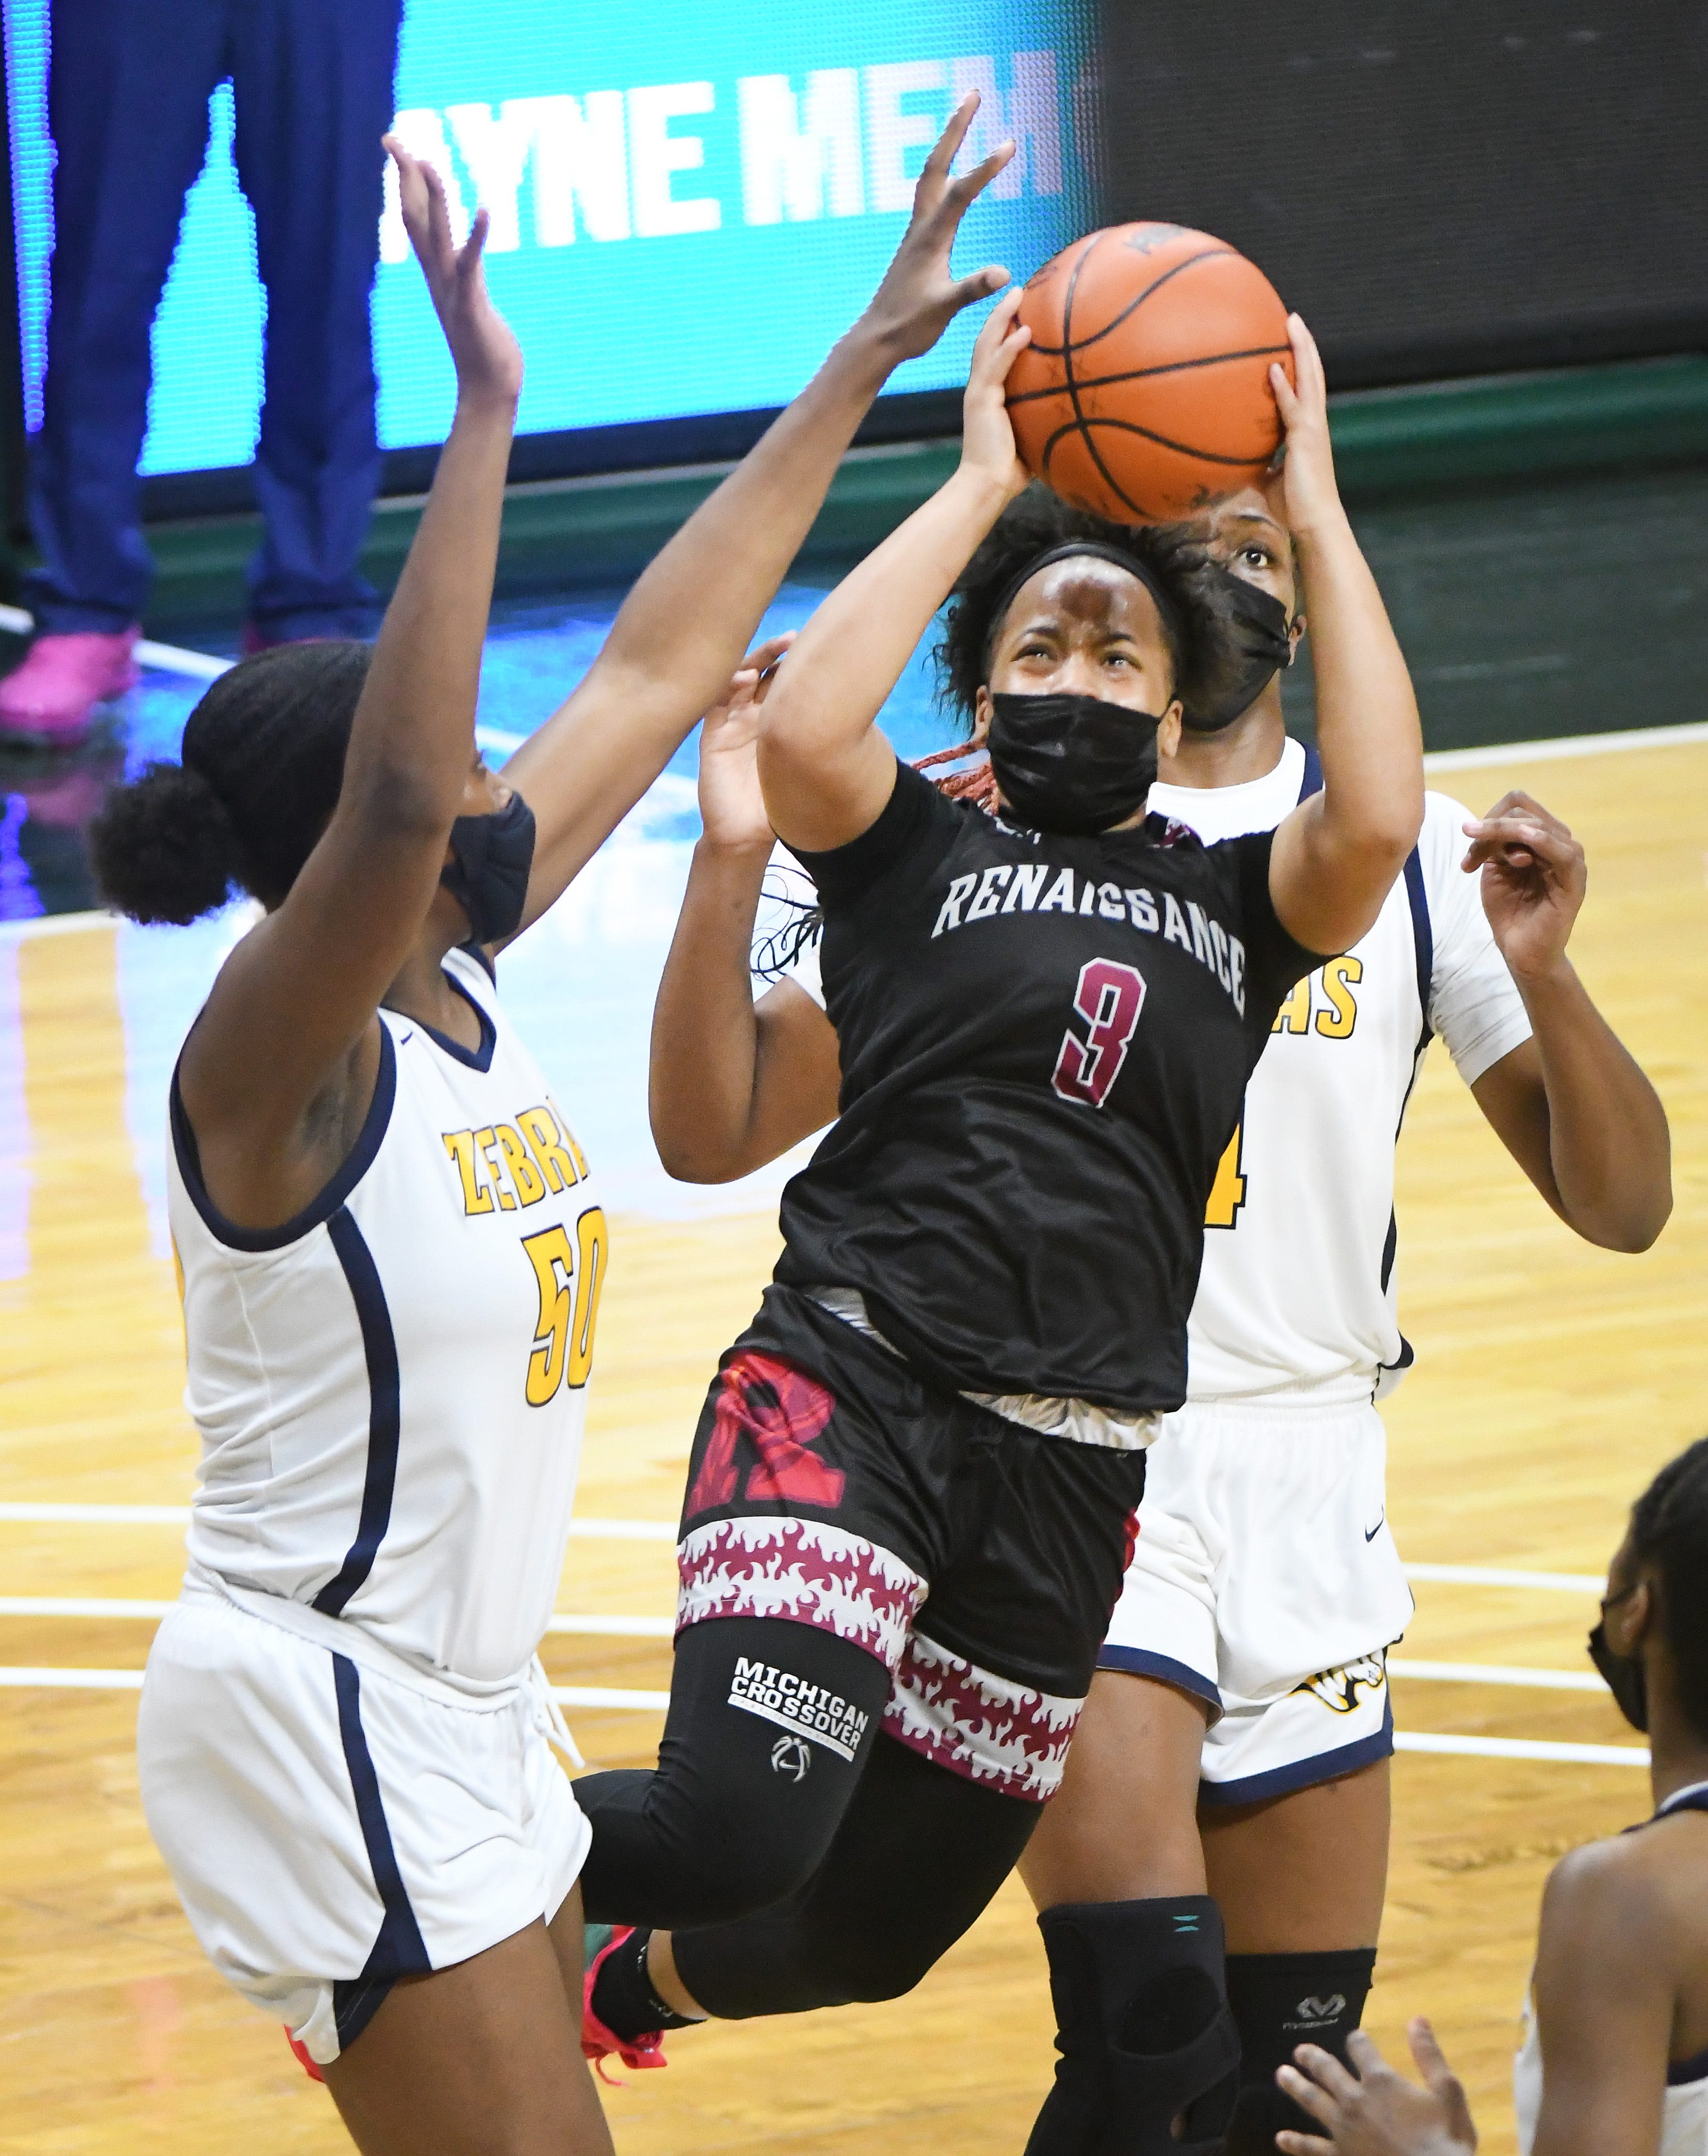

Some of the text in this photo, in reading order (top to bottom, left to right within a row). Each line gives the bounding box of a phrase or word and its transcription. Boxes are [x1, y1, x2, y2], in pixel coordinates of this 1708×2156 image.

[737, 51, 1101, 227] MEM
[931, 864, 1246, 1021] RENAISSANCE
[1051, 957, 1146, 1109] 3
[520, 1205, 608, 1407] 50
[731, 1676, 861, 1750] CROSSOVER
[734, 1656, 869, 1733] MICHIGAN
